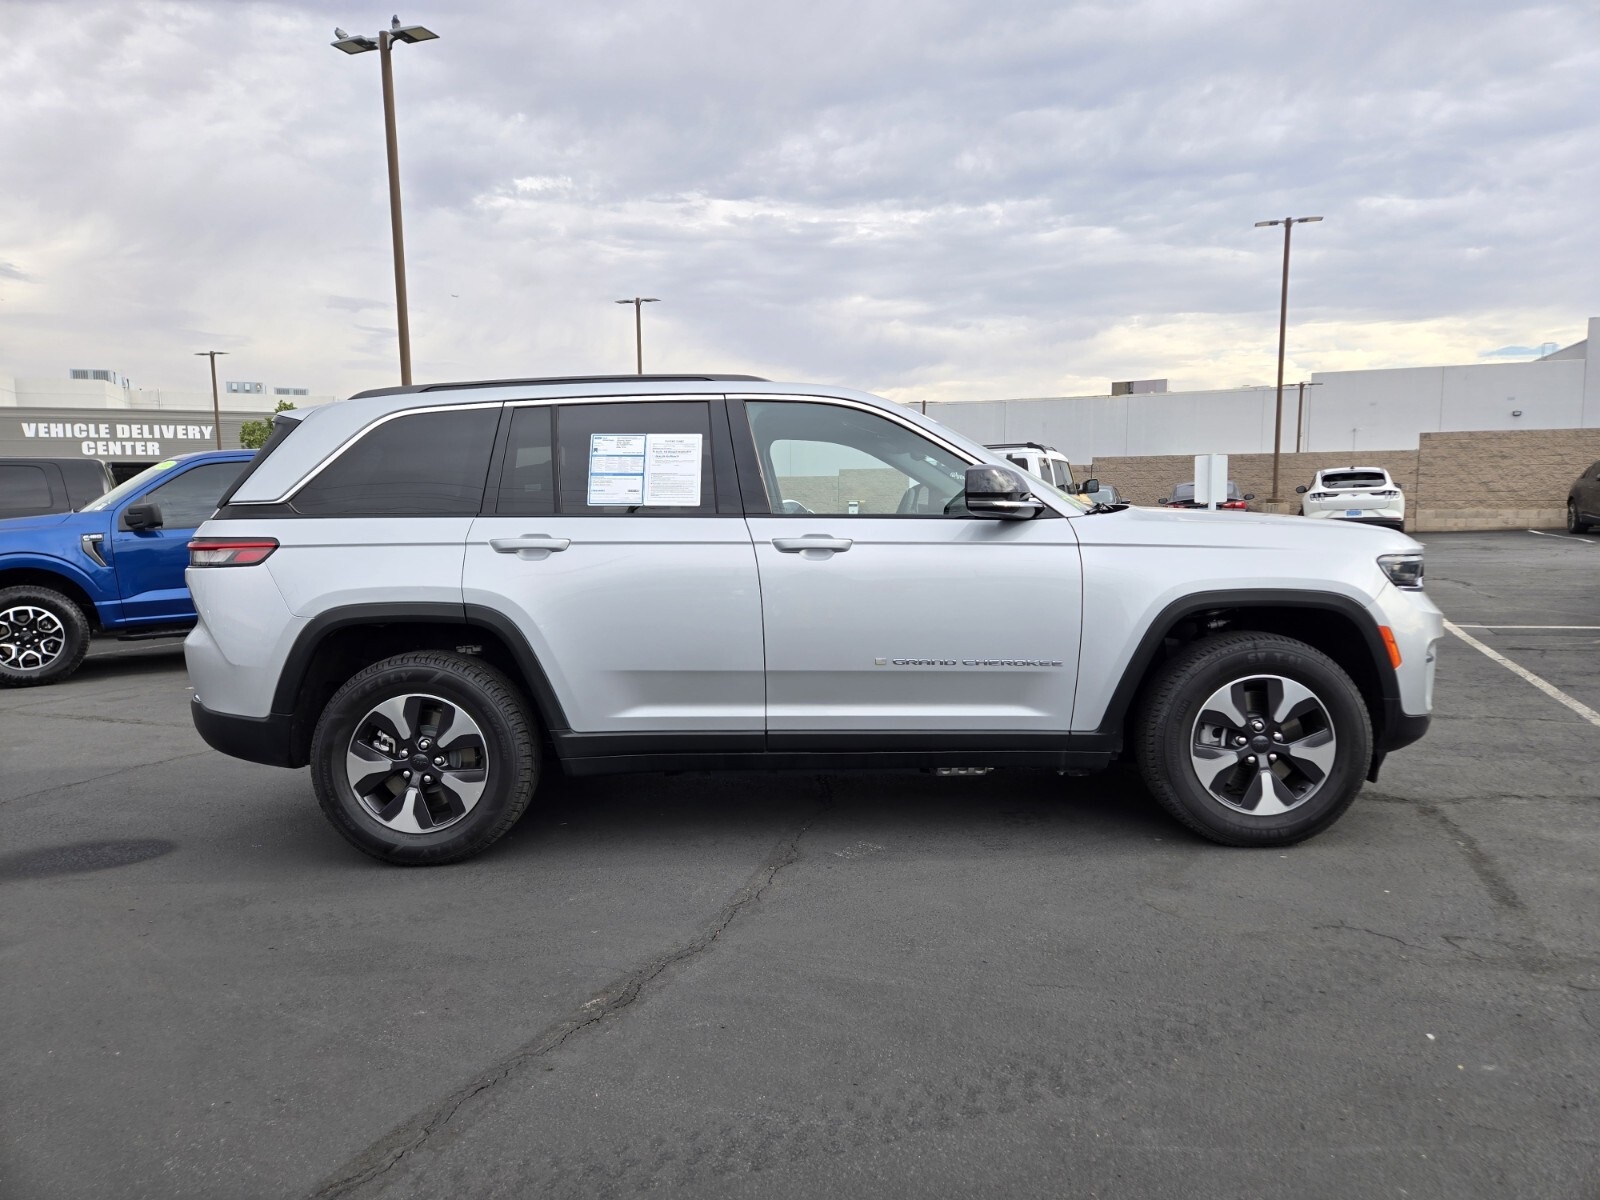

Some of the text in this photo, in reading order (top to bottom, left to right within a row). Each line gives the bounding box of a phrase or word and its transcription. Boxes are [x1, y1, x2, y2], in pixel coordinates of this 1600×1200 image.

[21, 422, 213, 440] VEHICLE DELIVERY
[81, 440, 160, 456] CENTER
[892, 658, 1064, 667] GRAND CHEROKEE
